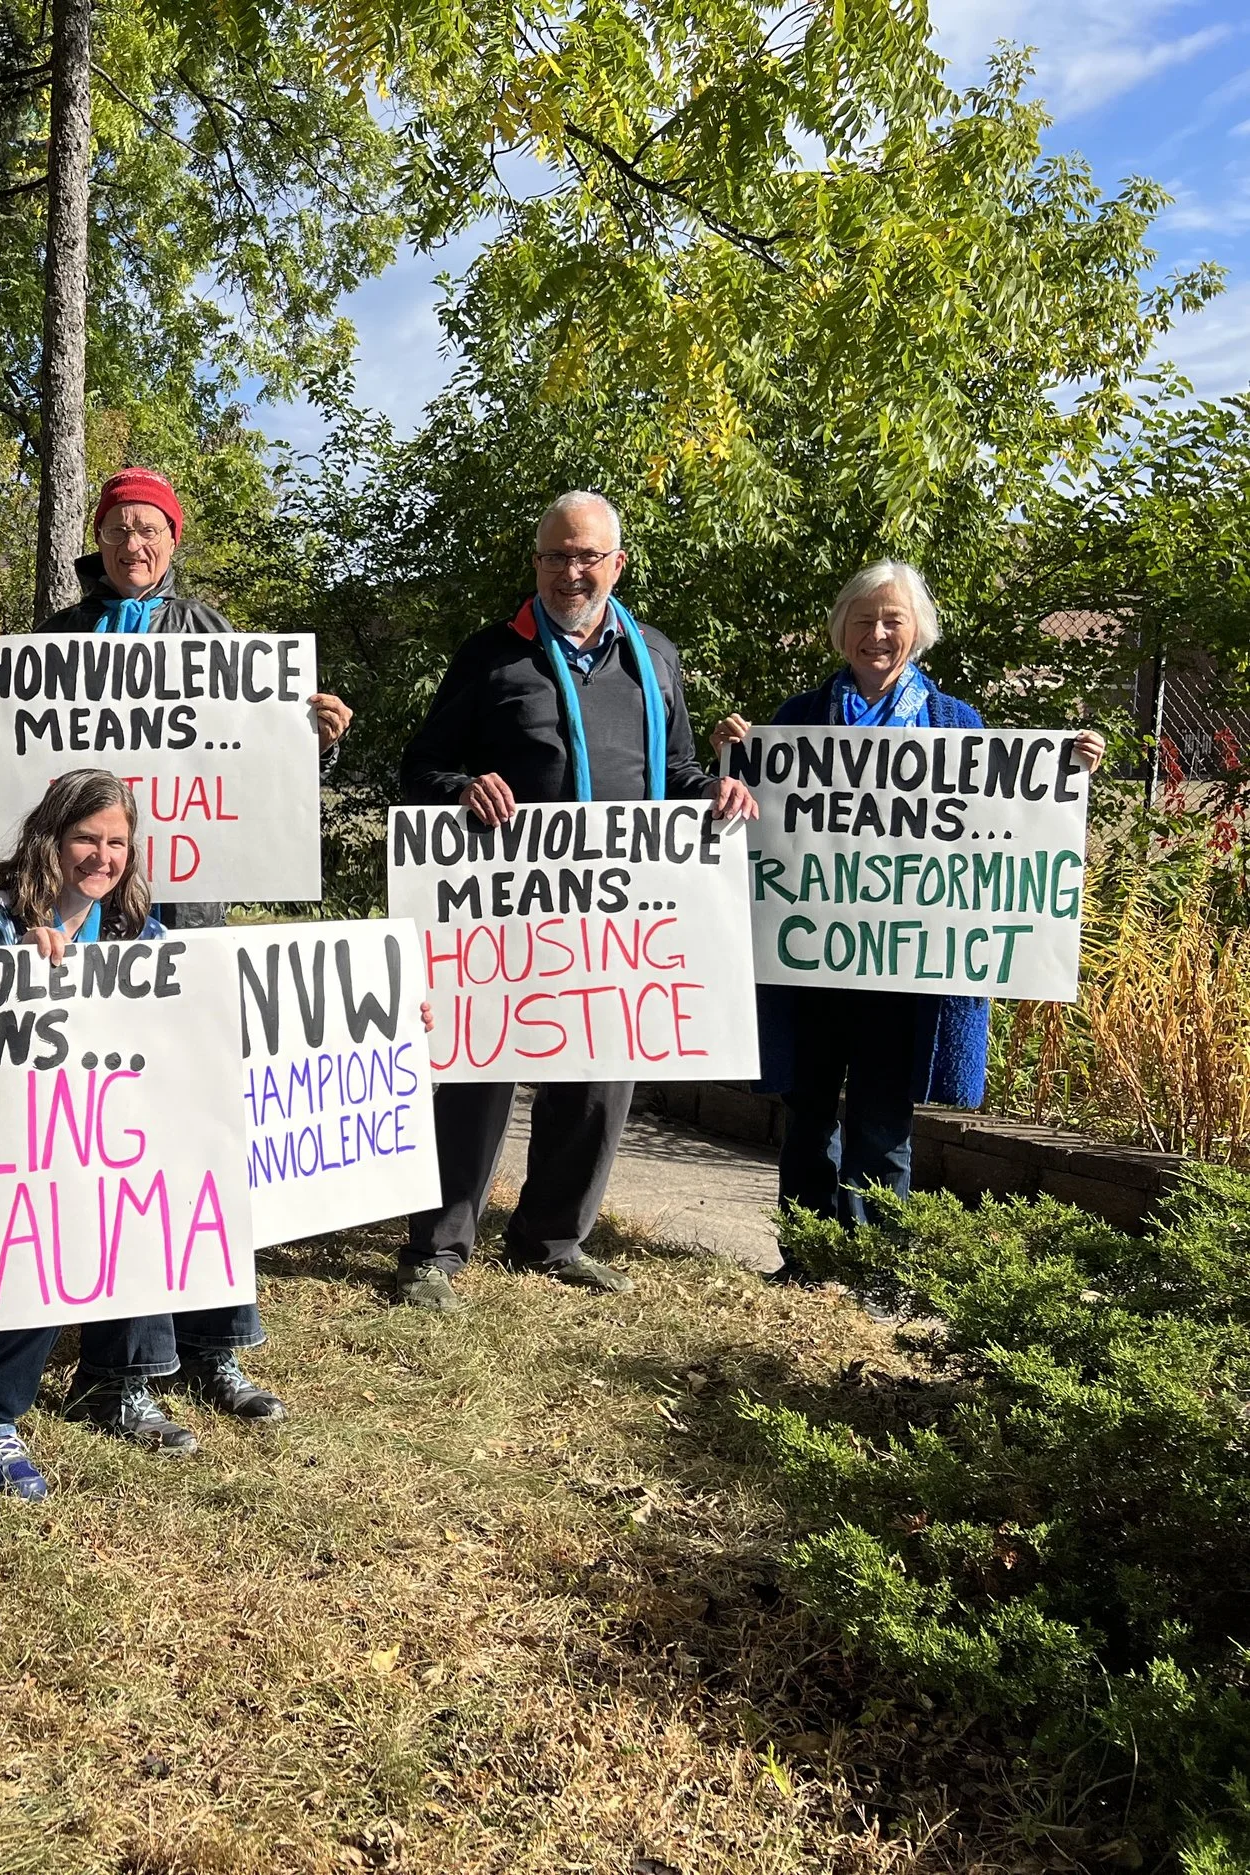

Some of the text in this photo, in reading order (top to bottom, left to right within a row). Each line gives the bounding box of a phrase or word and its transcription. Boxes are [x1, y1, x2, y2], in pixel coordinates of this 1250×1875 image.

[14, 705, 241, 755] MEANS...
[729, 736, 1082, 802] NONVIOLENCE
[394, 806, 721, 866] NONVIOLENCE
[784, 792, 1013, 841] MEANS...
[147, 834, 201, 882] ID
[438, 868, 676, 923] MEANS...
[426, 918, 685, 988] HOUSING
[777, 915, 1033, 984] CONFLICT
[237, 934, 401, 1059] NVW
[430, 982, 709, 1070] JUSTICE
[244, 1042, 418, 1127] HAMPIONS
